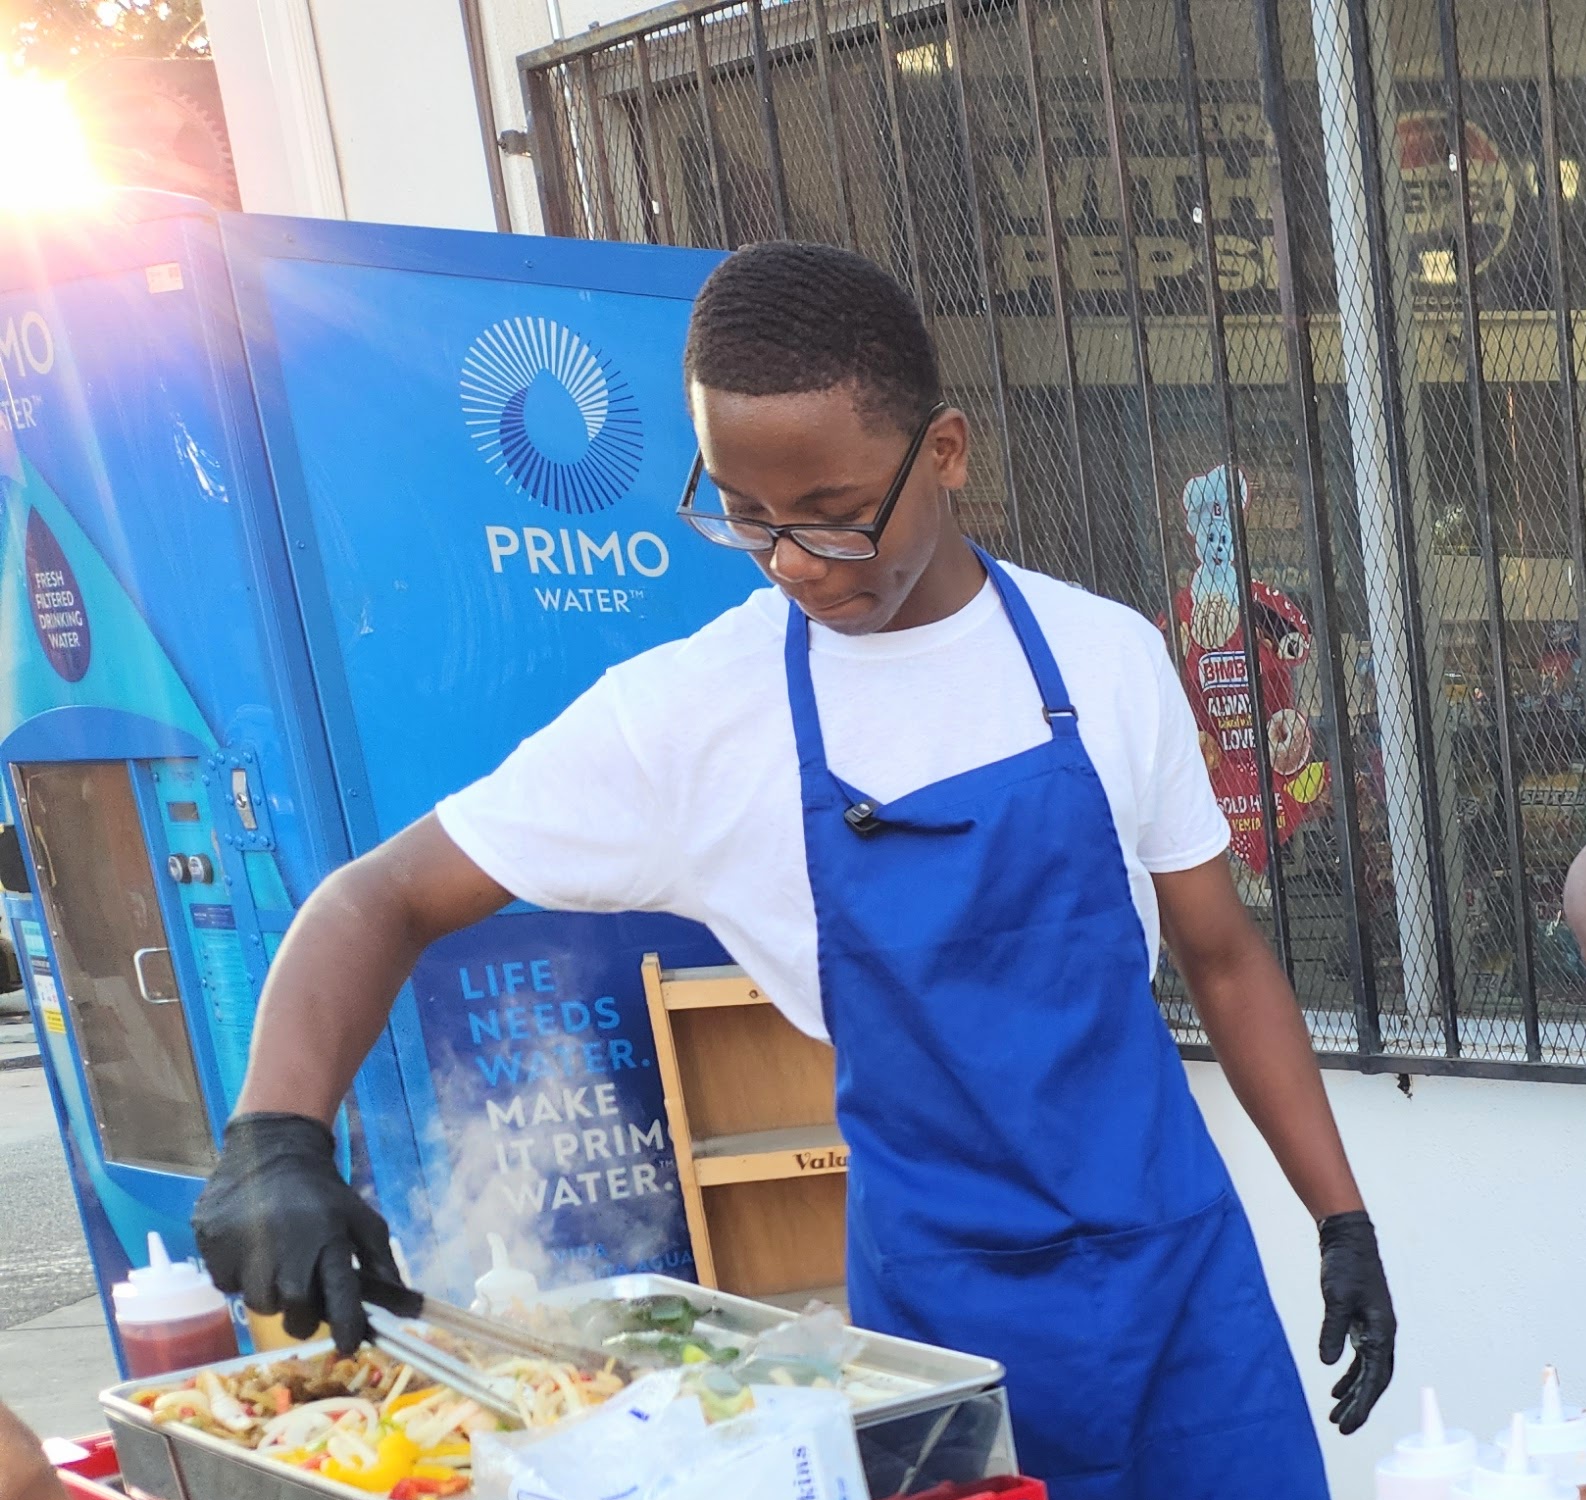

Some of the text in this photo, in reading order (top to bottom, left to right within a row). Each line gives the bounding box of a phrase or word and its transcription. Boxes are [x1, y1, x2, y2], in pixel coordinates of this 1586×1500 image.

[485, 526, 670, 578] PRIMO
[35, 571, 64, 588] FRESH
[35, 591, 74, 609] FILTERED
[39, 611, 83, 629] DRINKING
[48, 632, 80, 649] WATER
[1203, 658, 1250, 687] BIMB
[1221, 728, 1256, 750] LOVE
[460, 959, 556, 999] LIFE
[469, 997, 621, 1044] NEEDS
[475, 1038, 651, 1087] WATER.
[485, 1083, 620, 1132] MAKE
[495, 1119, 672, 1174] IT PRIM
